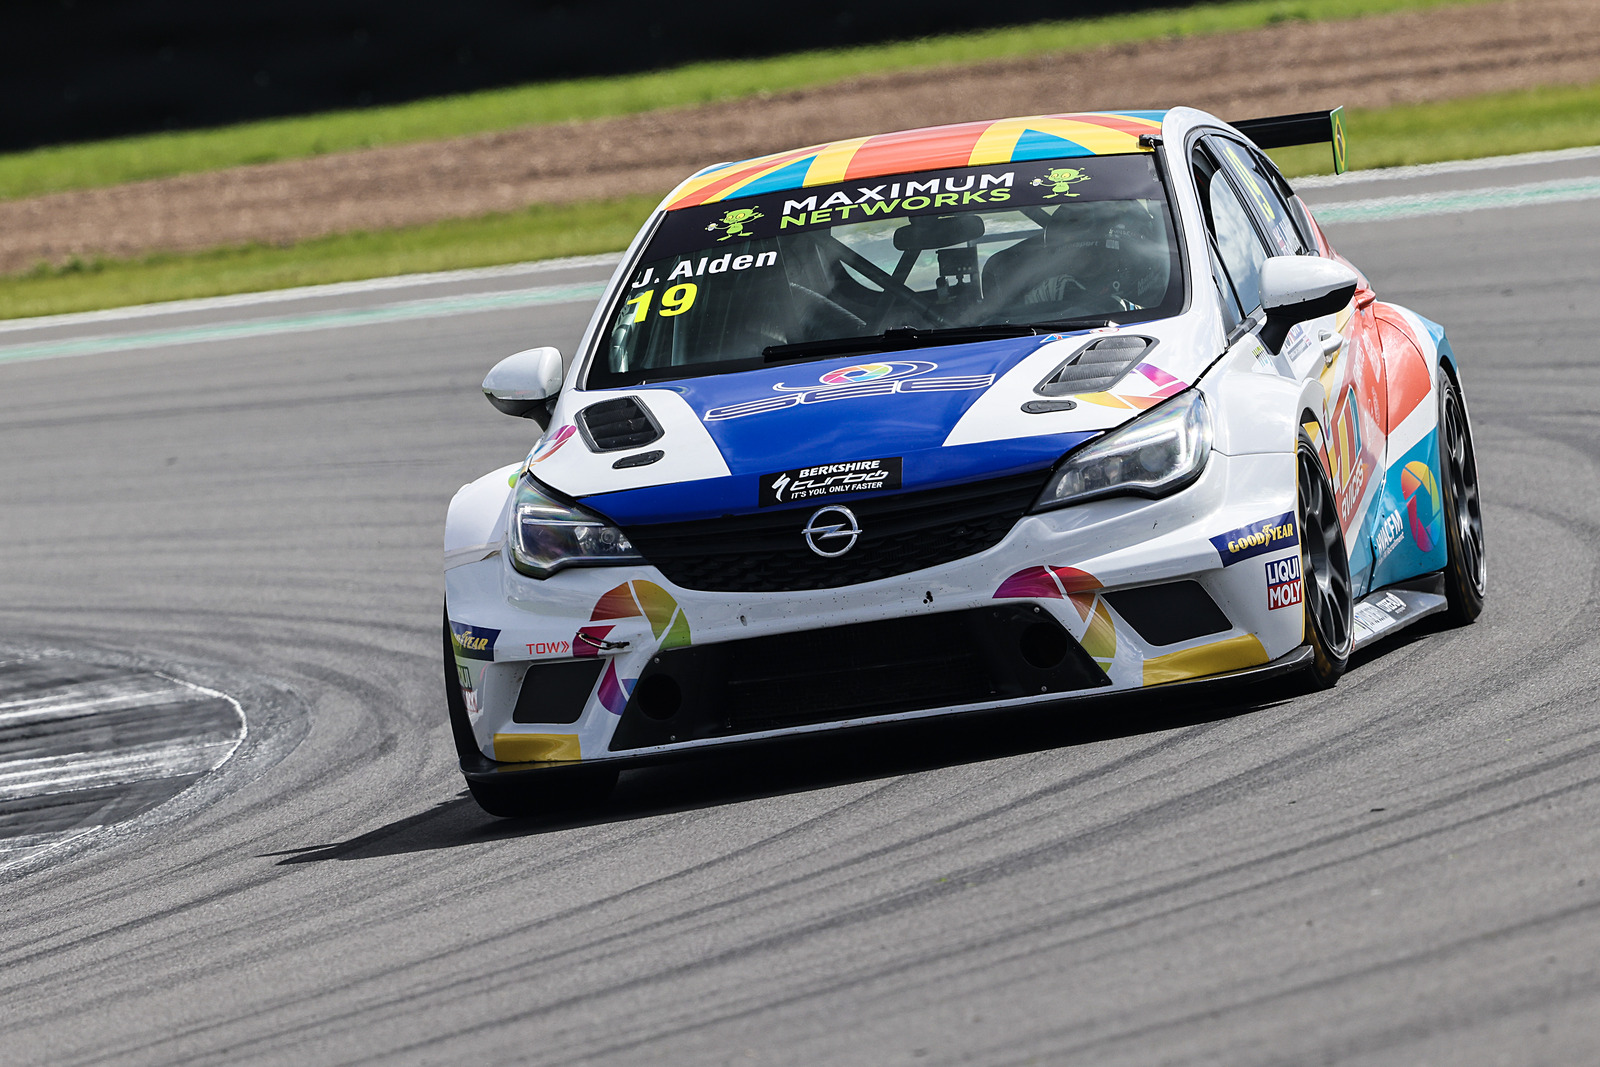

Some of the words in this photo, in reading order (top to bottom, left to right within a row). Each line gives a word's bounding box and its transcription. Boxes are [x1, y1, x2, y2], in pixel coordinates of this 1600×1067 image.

[780, 188, 1012, 229] NETWORKS
[783, 172, 1015, 216] MAXIMUM
[631, 267, 660, 289] J.
[667, 251, 778, 281] Alden
[626, 282, 698, 323] 19
[789, 470, 889, 491] turbo
[799, 460, 881, 478] BERKSHIRE
[790, 490, 807, 500] IT'S
[809, 488, 827, 497] YOU.
[829, 485, 849, 493] ONLY
[851, 481, 883, 491] FASTER
[1227, 523, 1294, 554] GOODYEAR
[1266, 557, 1300, 585] LIQUI
[1269, 580, 1301, 609] MOLY
[525, 641, 561, 655] TOW
